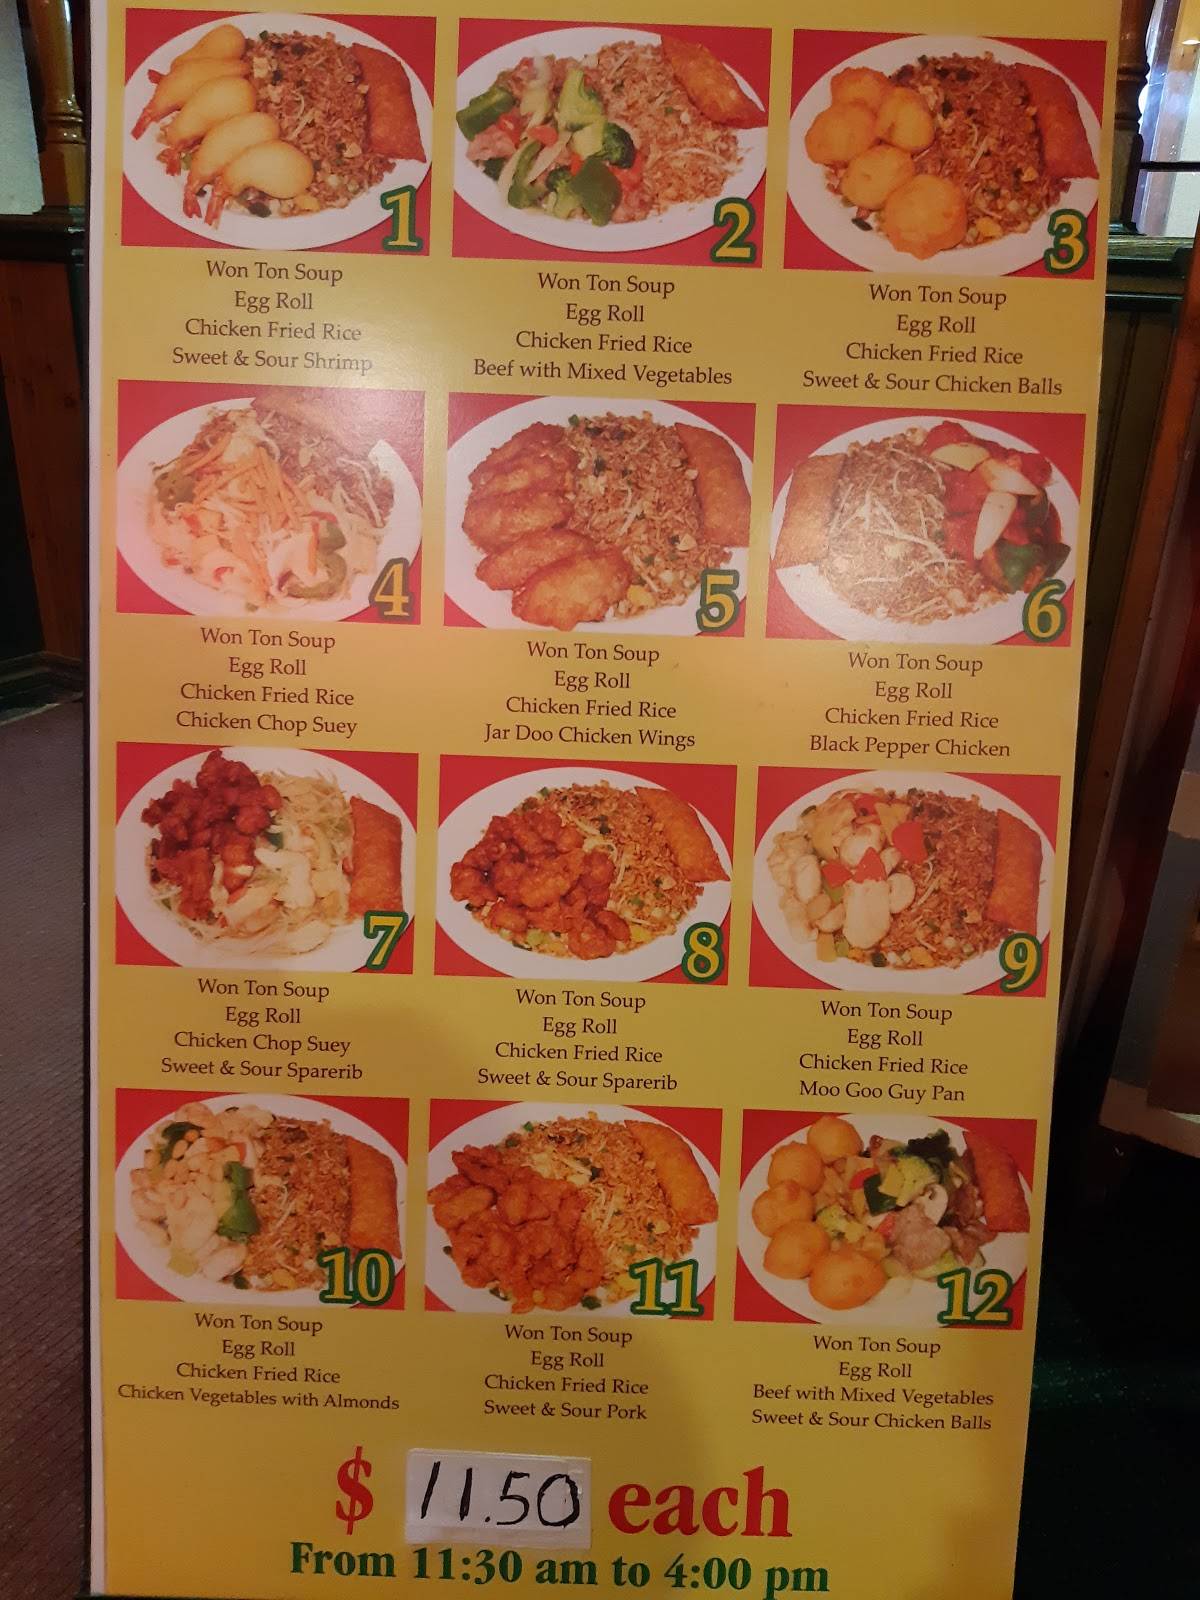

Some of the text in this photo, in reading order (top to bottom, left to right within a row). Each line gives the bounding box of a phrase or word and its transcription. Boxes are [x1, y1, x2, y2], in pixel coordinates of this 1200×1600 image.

[380, 186, 422, 250] 1
[710, 198, 757, 263] 2
[1044, 209, 1090, 273] 3
[205, 259, 343, 288] Won Ton Soup
[538, 271, 675, 300] Won Ton Soup
[234, 289, 313, 314] Egg Roll
[869, 282, 1007, 311] Won Ton Soup
[185, 317, 362, 341] Chicken Fried Rice
[897, 313, 976, 338] Egg Roll
[515, 329, 693, 353] Chicken Fried Rice
[845, 341, 1024, 365] Chicken Fried Rice
[172, 346, 373, 376] Sweet & Sour Shrimp
[474, 357, 733, 388] Beef with Mixed Vegetables
[802, 369, 1063, 395] Sweet & Sour Chicken Balls
[370, 557, 410, 621] 4
[696, 570, 739, 633] 5
[1022, 578, 1065, 640] 6
[200, 626, 336, 654] Won Ton Soup
[526, 640, 660, 667] Won Ton Soup
[848, 651, 984, 677] Won Ton Soup
[180, 682, 355, 706] Chicken Fried Rice
[505, 695, 677, 719] Chicken Fried Rice
[175, 709, 358, 739] Chicken Chop Suey
[824, 706, 999, 729] Chicken Fried Rice
[483, 722, 696, 752] Jar Doo Chicken Wings
[810, 733, 1010, 759] Black Pepper Chicken
[364, 910, 408, 970] 7
[680, 922, 724, 983] 8
[1000, 932, 1042, 992] 9
[197, 976, 330, 1003] Won Ton Soup
[515, 987, 646, 1014] Won Ton Soup
[820, 999, 953, 1025] Won Ton Soup
[173, 1030, 352, 1058] Chicken Chop Suey
[495, 1041, 663, 1063] Chicken Fried Rice
[847, 1027, 923, 1050] Egg Roll
[161, 1056, 363, 1083] Sweet & Sour Sparerib
[799, 1052, 969, 1075] Chicken Fried Rice
[477, 1067, 678, 1094] Sweet & Sour Sparerib
[799, 1078, 965, 1105] Moo Goo Guy Pan
[319, 1248, 394, 1305] 10
[629, 1259, 702, 1315] 11
[937, 1267, 1012, 1327] 12
[194, 1311, 324, 1337] Won Ton Soup
[504, 1323, 633, 1348] Won Ton Soup
[813, 1334, 942, 1358] Won Ton Soup
[176, 1361, 341, 1384] Chicken Fried Rice
[484, 1372, 649, 1395] Chicken Fried Rice
[839, 1360, 912, 1382] Egg Roll
[117, 1383, 400, 1410] Chicken Vegetables with Almonds
[753, 1382, 994, 1409] Beef with Mixed Vegetables
[483, 1399, 648, 1420] Sweet & Sour Pork
[751, 1408, 992, 1430] Sweet & Sour Chicken Balls
[334, 1446, 792, 1538] $ 11.50 each
[291, 1541, 830, 1600] From 11:30 am to 4:00 pm
